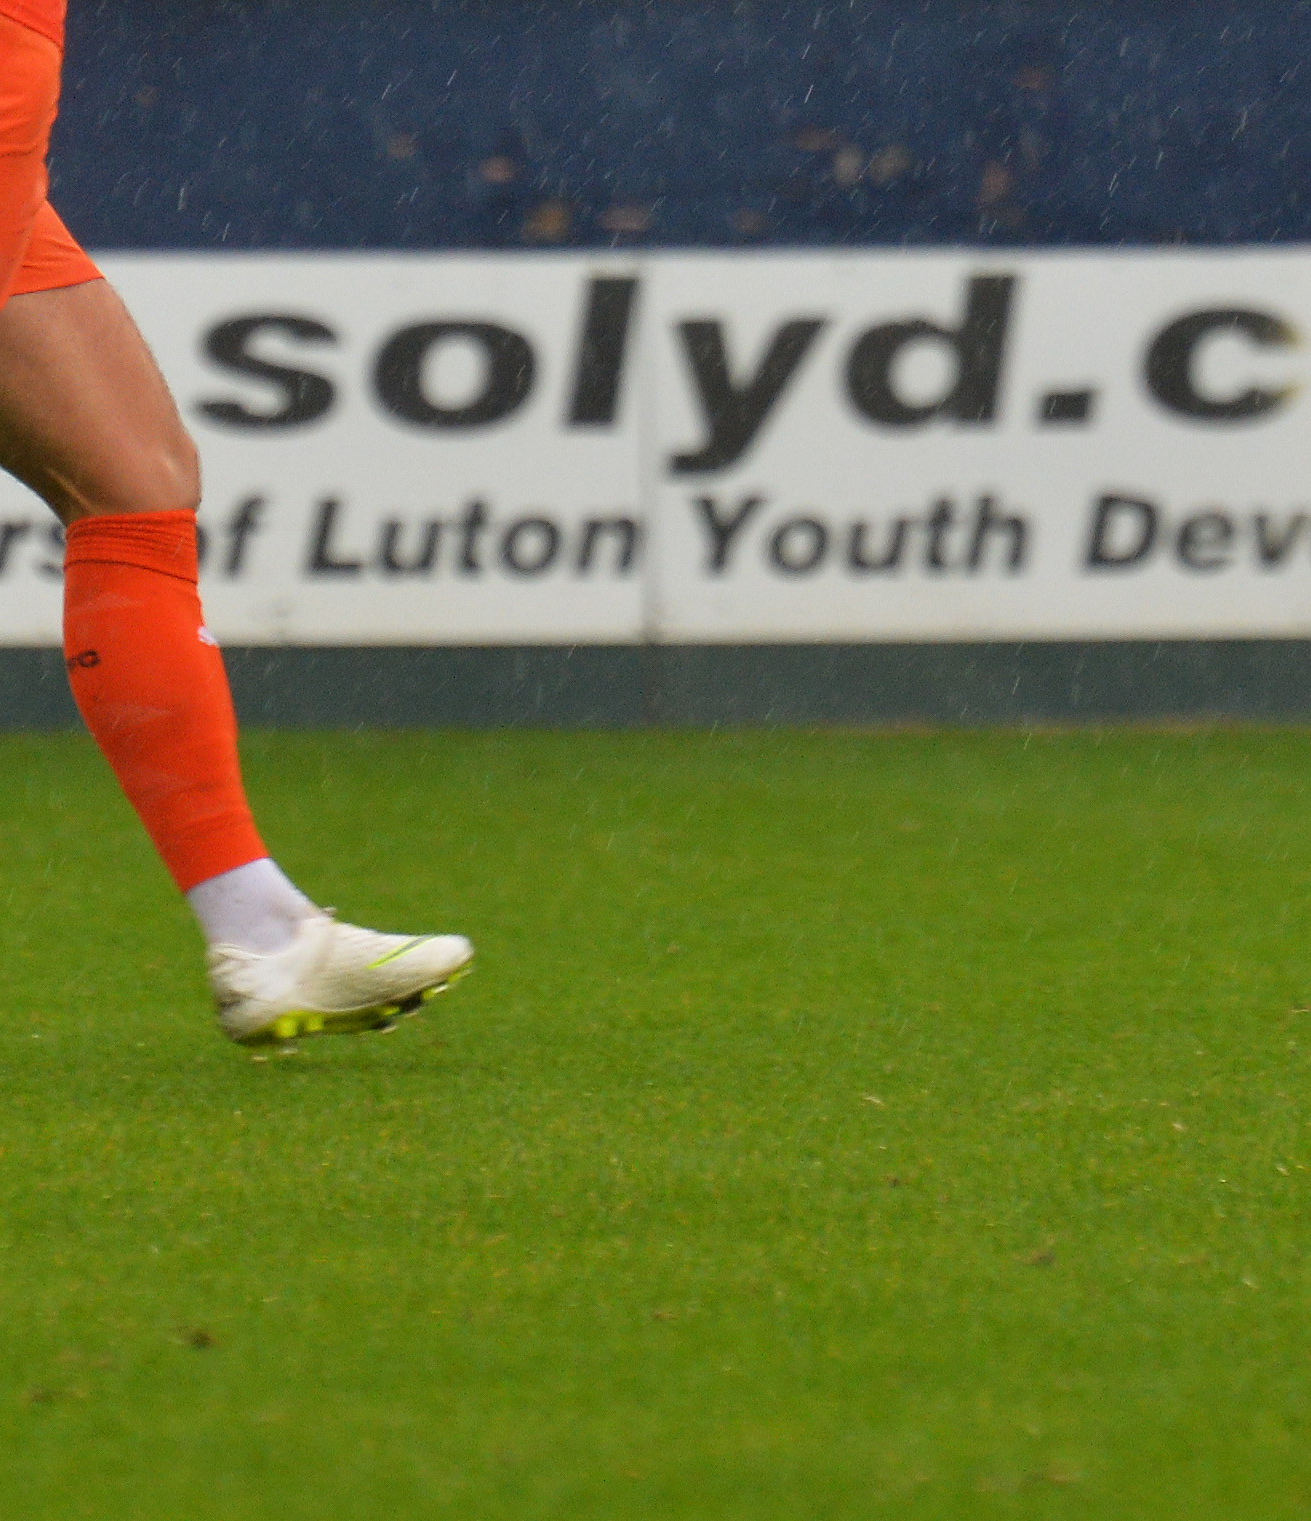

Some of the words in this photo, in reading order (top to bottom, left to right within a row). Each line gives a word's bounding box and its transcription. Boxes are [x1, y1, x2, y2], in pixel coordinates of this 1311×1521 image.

[303, 496, 647, 580] Luton
[693, 492, 1033, 580] Youth
[1082, 491, 1311, 577] Dev
